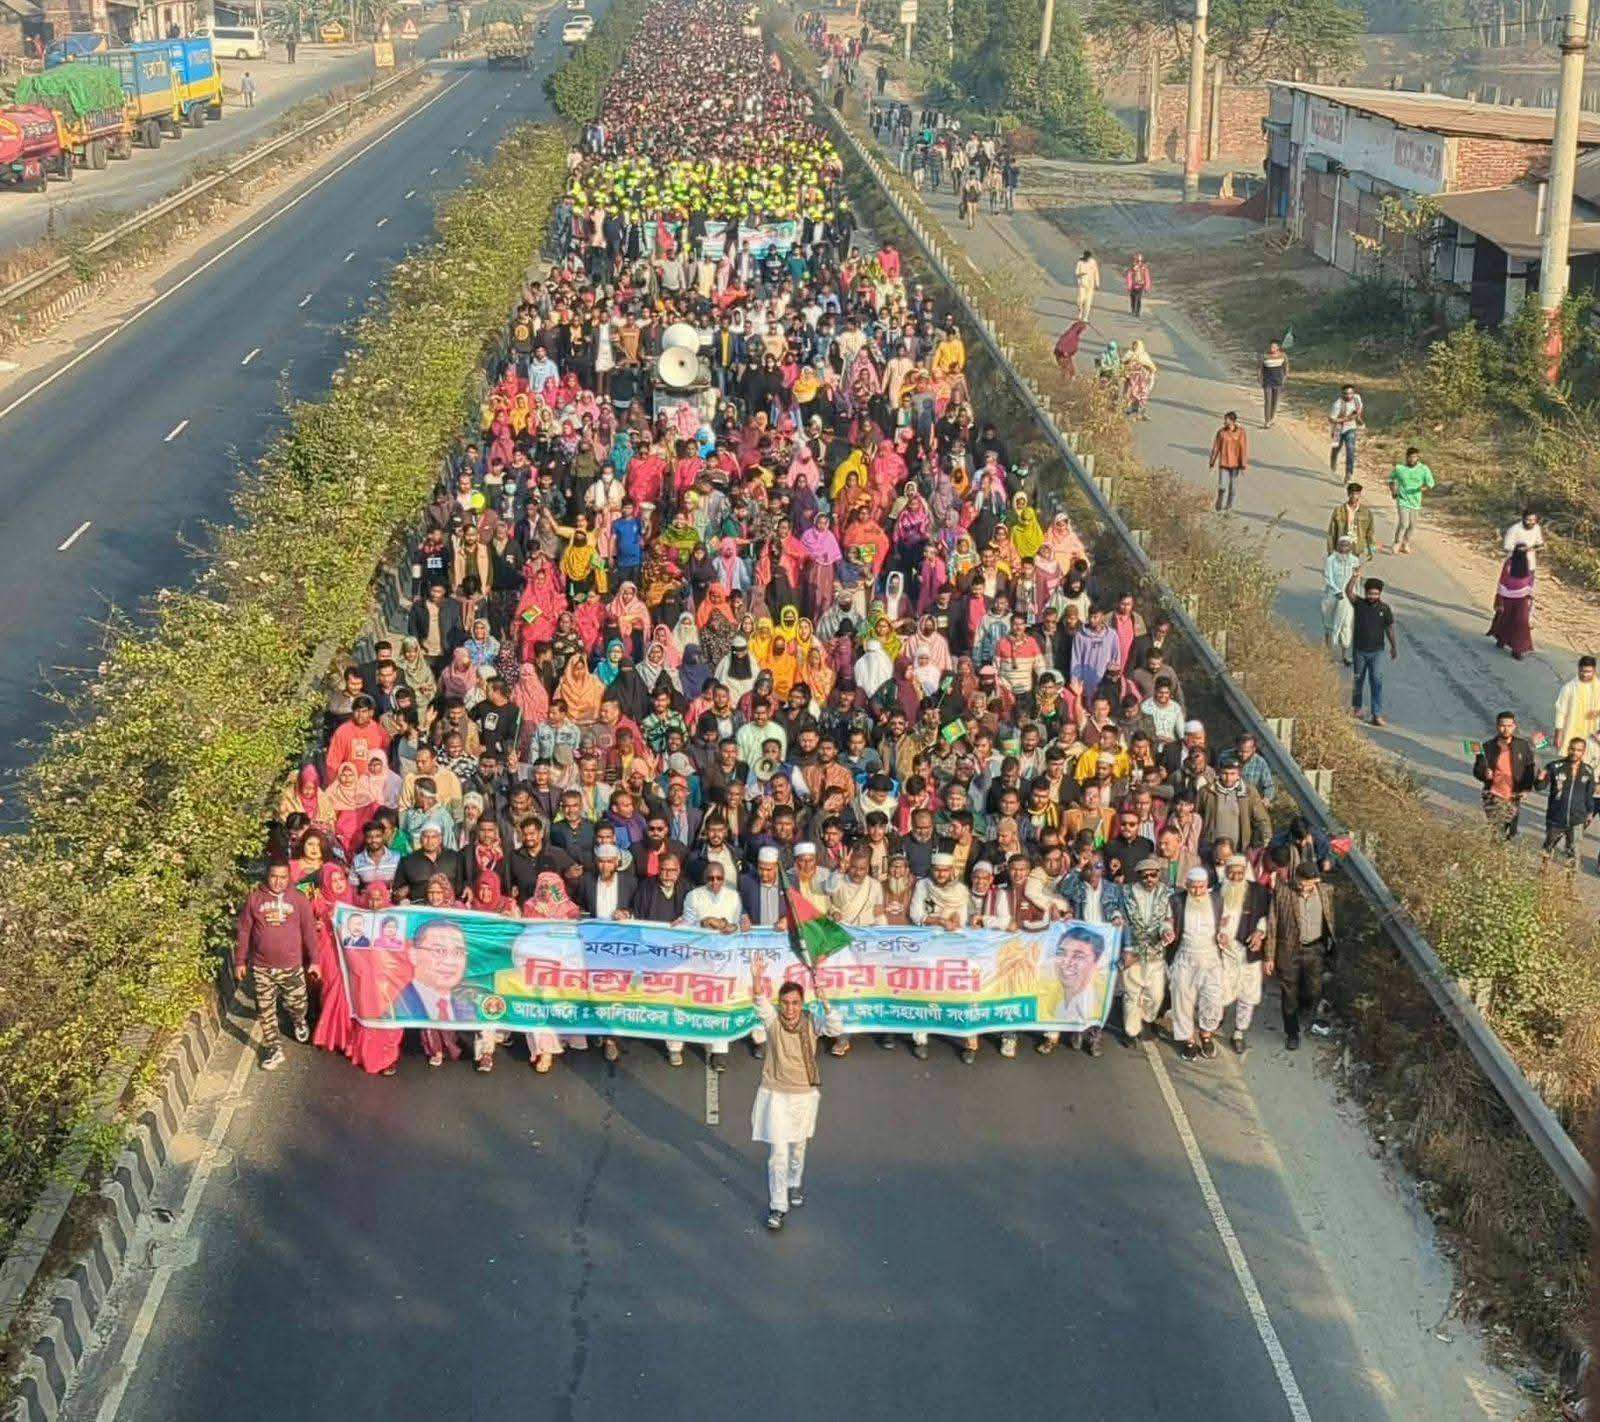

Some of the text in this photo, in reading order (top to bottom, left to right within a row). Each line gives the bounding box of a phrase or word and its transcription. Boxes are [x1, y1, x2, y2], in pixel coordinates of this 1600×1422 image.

[584, 941, 640, 956] মহান
[877, 936, 922, 953] প্রতি
[522, 957, 633, 993] বিনম্র
[642, 970, 737, 1004] শ্রদ্ধা
[784, 963, 877, 993] বিজয়
